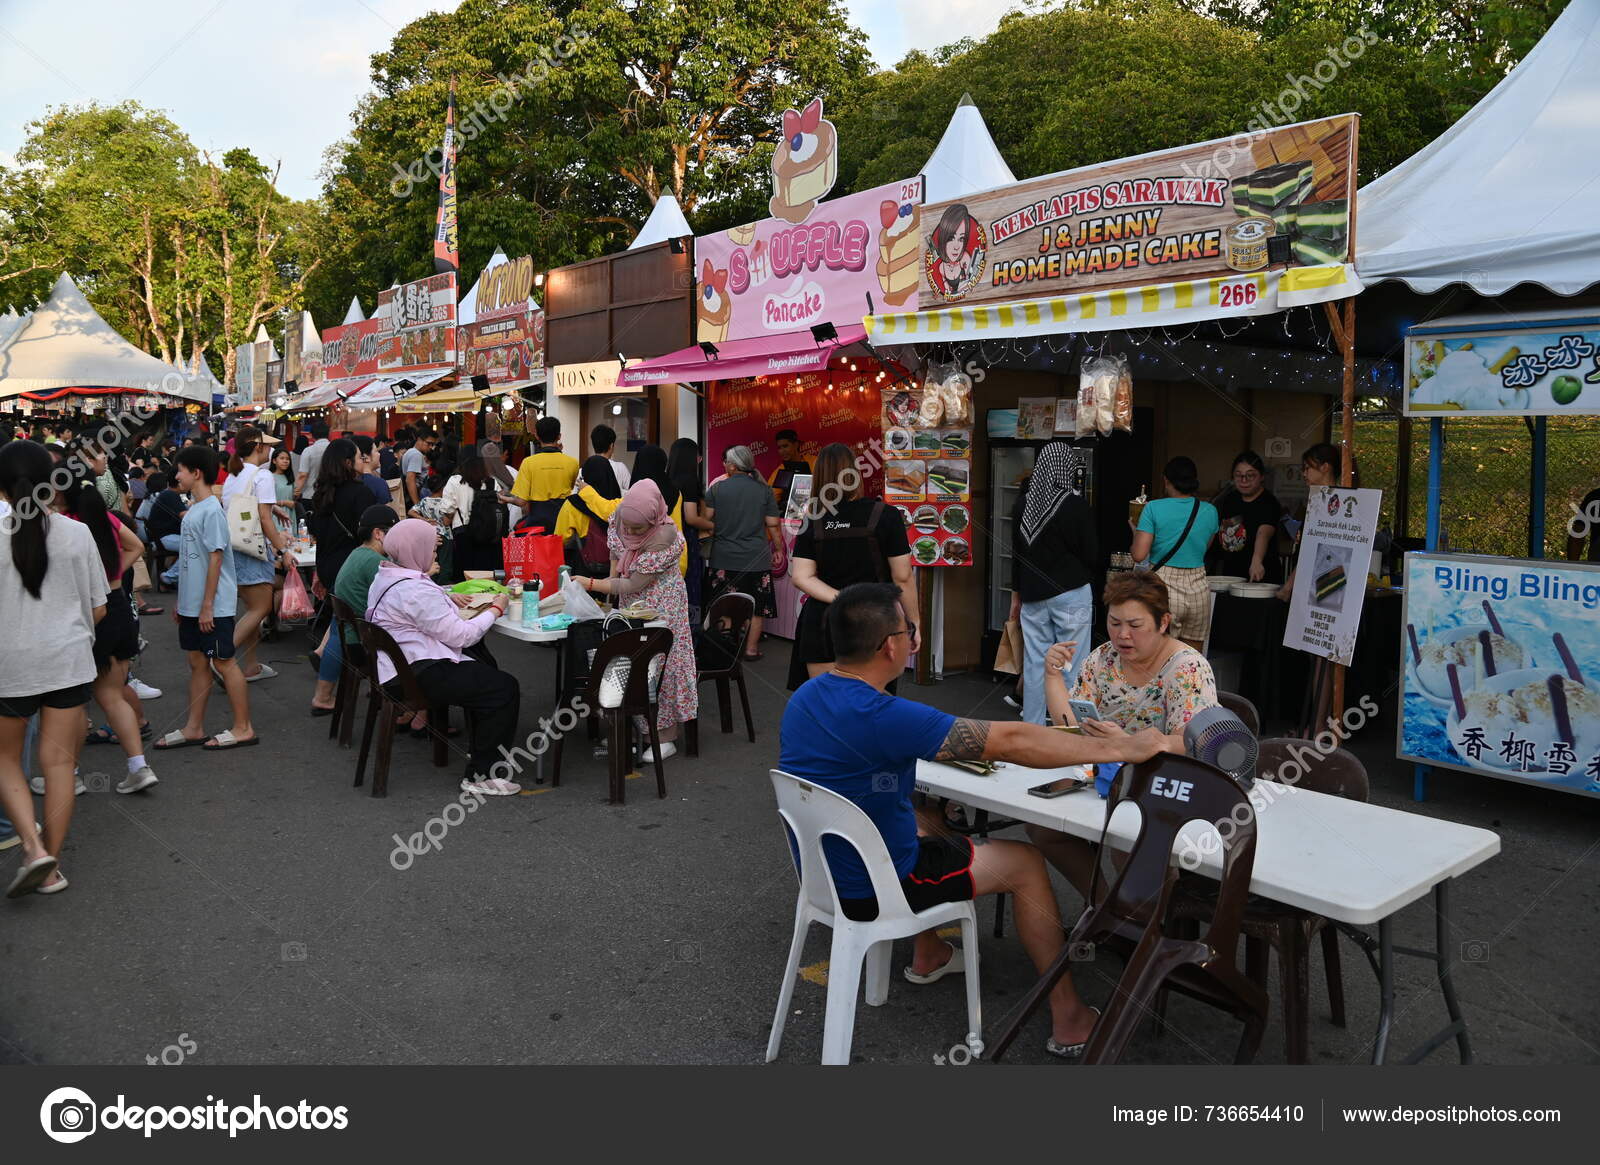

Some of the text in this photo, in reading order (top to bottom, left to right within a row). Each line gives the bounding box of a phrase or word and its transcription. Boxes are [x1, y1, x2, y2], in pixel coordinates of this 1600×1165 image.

[901, 181, 921, 200] 267
[992, 177, 1229, 245] KEK LAPIS SARAWAK
[1038, 208, 1162, 253] J & JENNY
[992, 230, 1222, 287] HOME MADE CAKE
[765, 291, 823, 324] Pancake
[1220, 282, 1257, 307] 266
[768, 358, 787, 370] Depo
[1501, 336, 1600, 388] 冰冰
[557, 369, 596, 389] MONS
[1317, 520, 1337, 529] Sarawak
[1348, 523, 1361, 532] Lapis
[1328, 531, 1342, 540] Home
[1343, 533, 1355, 541] Made
[1356, 534, 1369, 544] Cake
[1435, 566, 1600, 609] Bling Bling
[1150, 776, 1194, 802] EJE
